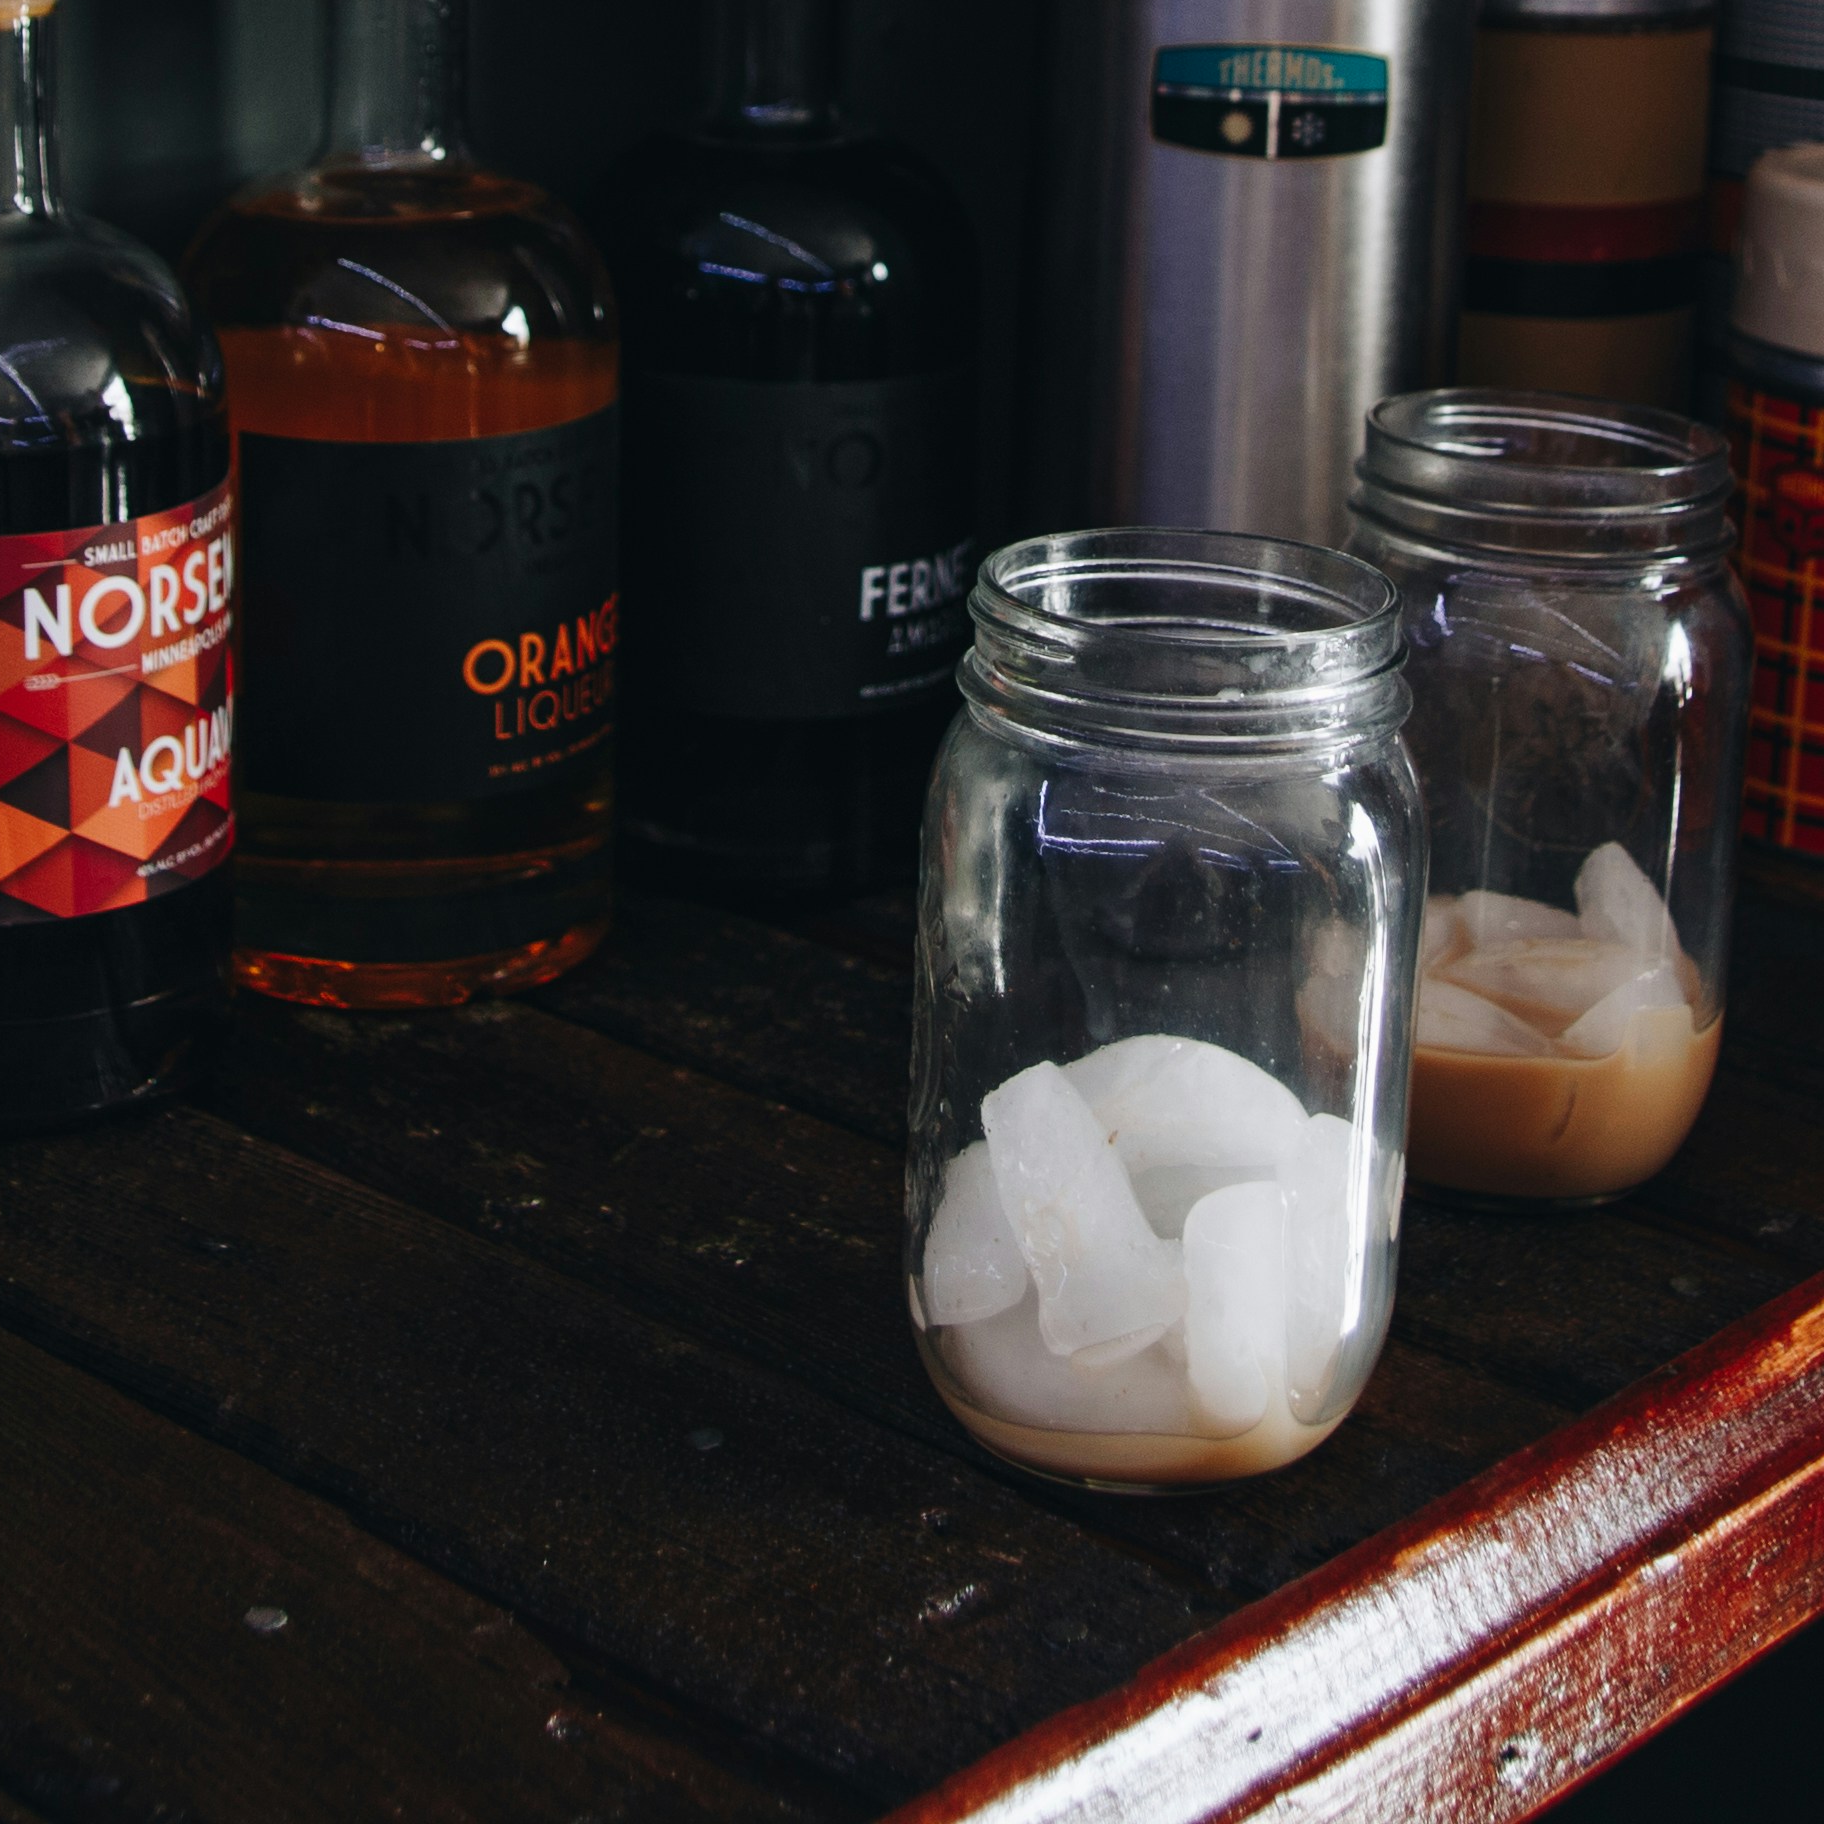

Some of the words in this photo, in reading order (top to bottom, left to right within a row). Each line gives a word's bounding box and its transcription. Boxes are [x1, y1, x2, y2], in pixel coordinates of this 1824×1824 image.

[1219, 48, 1337, 87] THERMOS
[84, 540, 137, 567] SMALL
[141, 524, 189, 555] BATCH
[859, 538, 973, 623] FERNE
